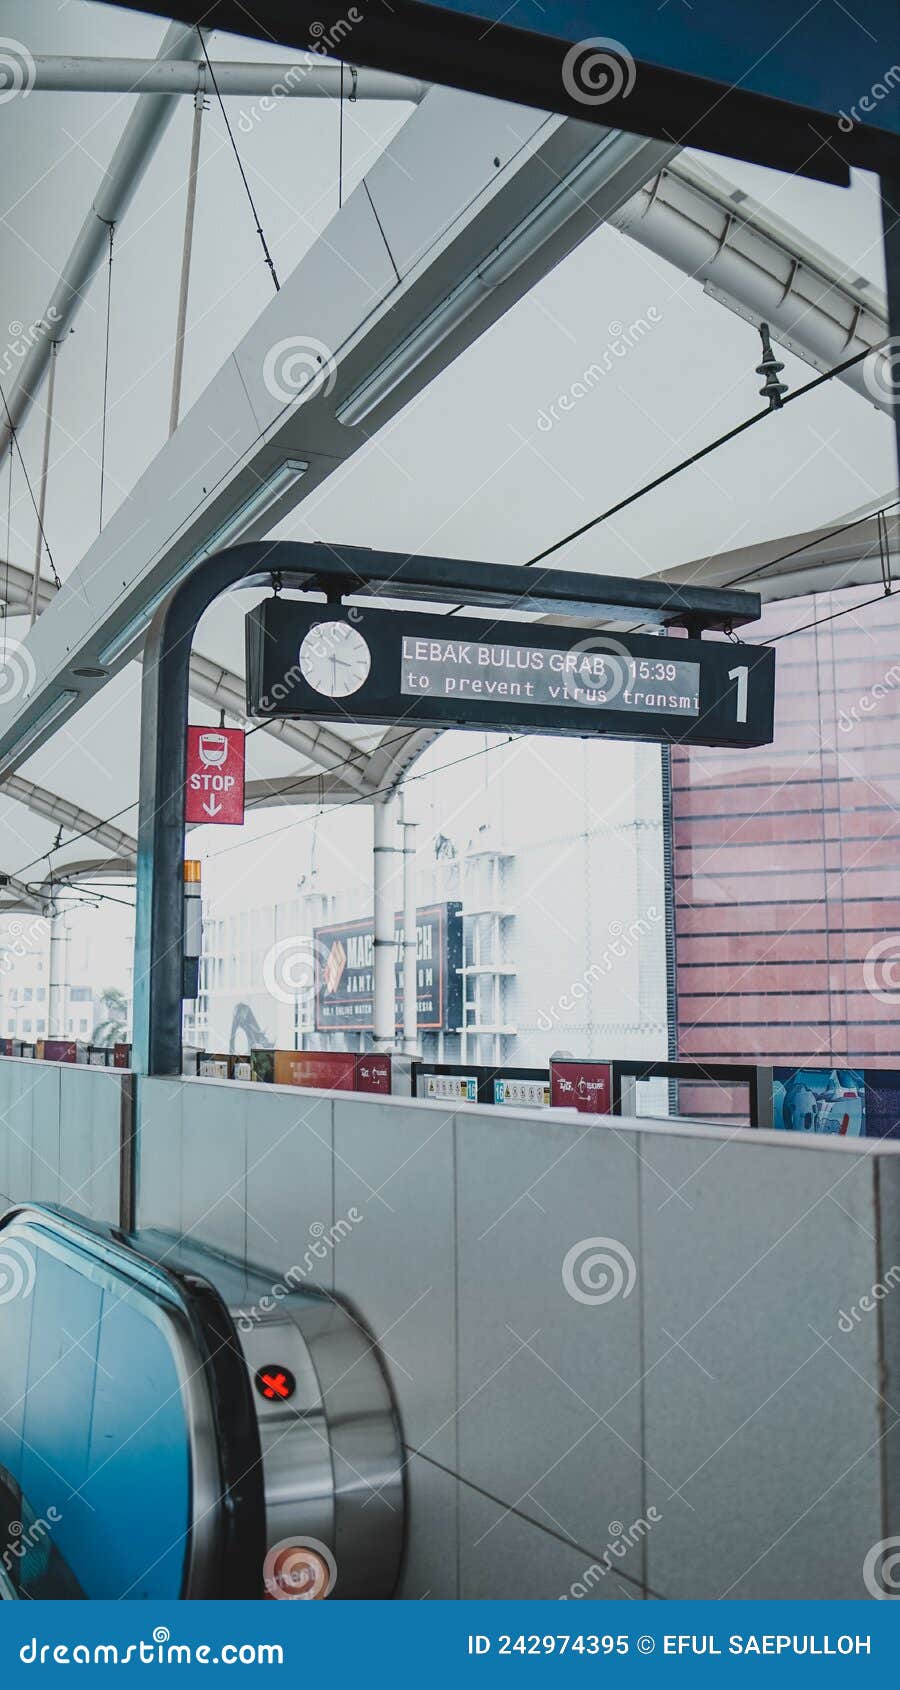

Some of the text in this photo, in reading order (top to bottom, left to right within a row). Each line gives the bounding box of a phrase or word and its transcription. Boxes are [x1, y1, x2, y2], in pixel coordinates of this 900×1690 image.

[403, 640, 677, 682] LEBAK BULUS GRAB 15:39
[408, 672, 430, 688] to
[445, 676, 534, 697] prevent
[548, 682, 608, 703] virus
[728, 665, 749, 723] 1
[190, 773, 235, 791] STOP
